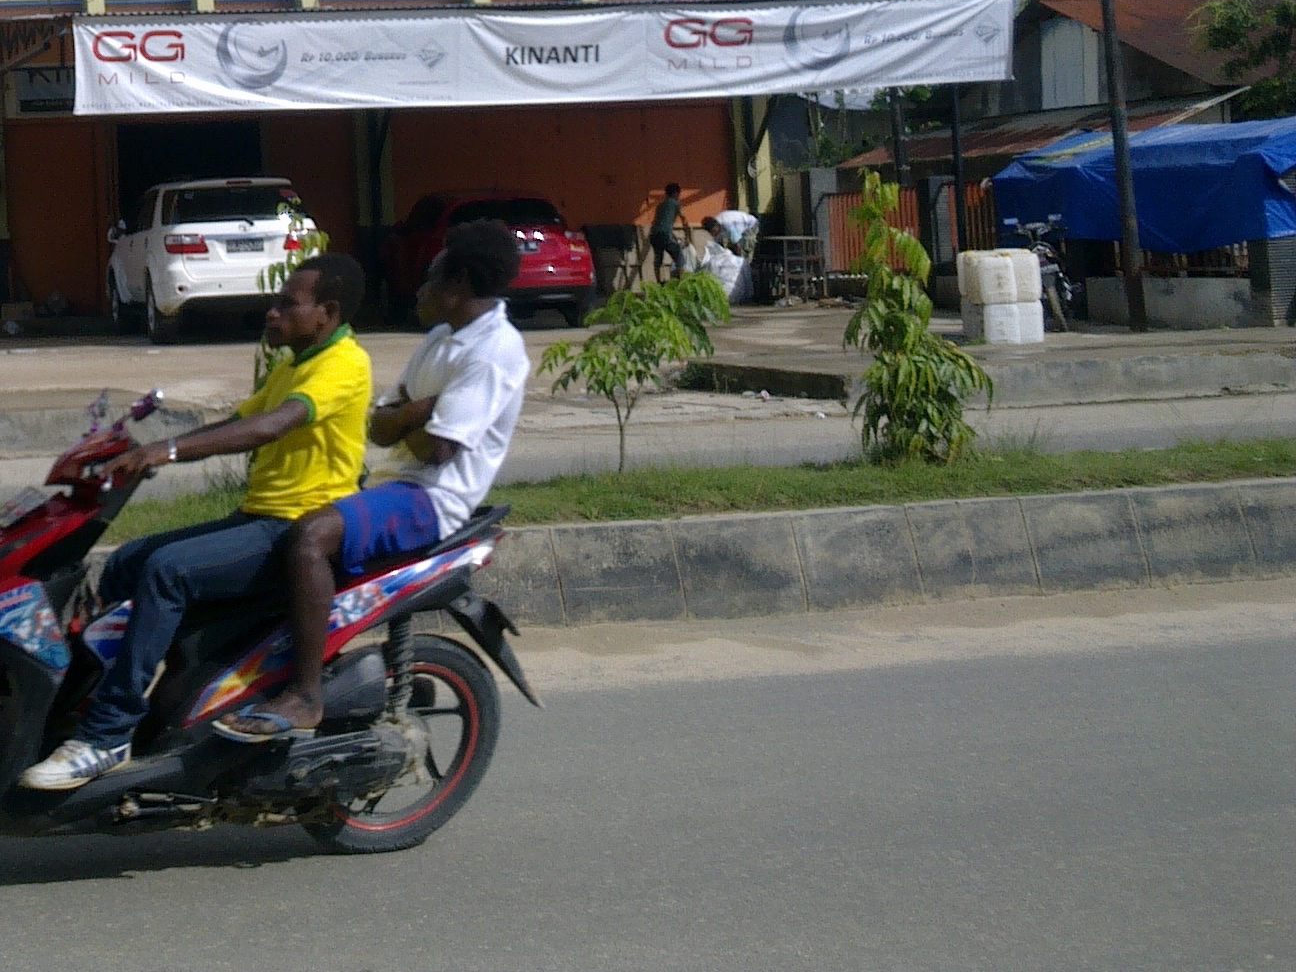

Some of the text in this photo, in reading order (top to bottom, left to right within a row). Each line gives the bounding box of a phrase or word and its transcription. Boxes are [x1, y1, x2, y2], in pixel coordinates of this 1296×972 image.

[664, 17, 753, 49] GG
[92, 30, 185, 62] GG
[506, 44, 599, 65] KINANTI
[668, 56, 752, 70] MILD
[98, 72, 185, 85] MILD
